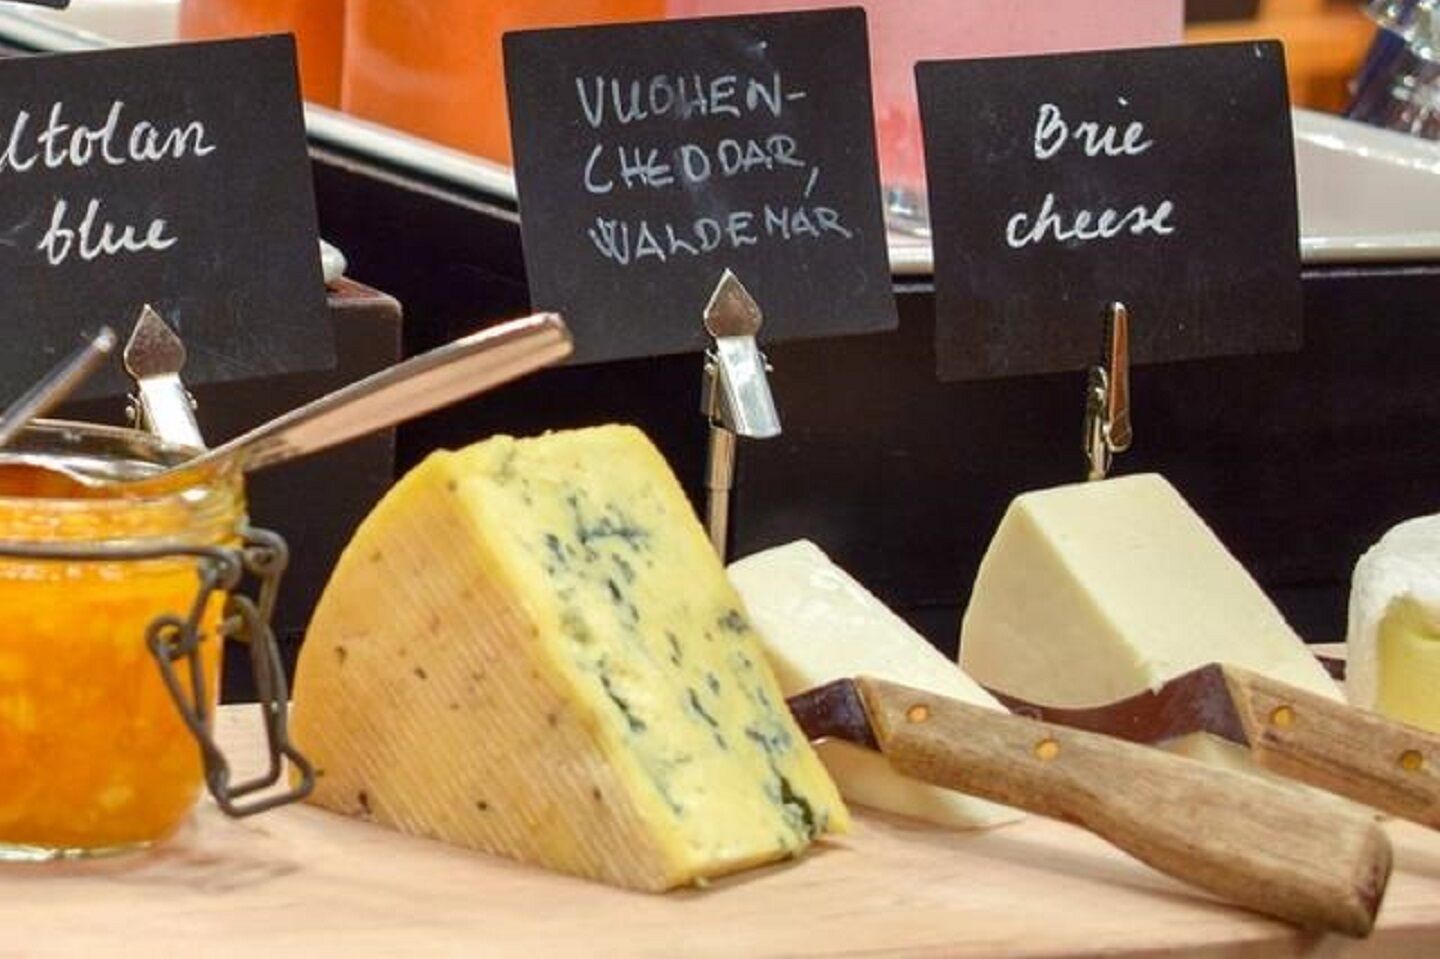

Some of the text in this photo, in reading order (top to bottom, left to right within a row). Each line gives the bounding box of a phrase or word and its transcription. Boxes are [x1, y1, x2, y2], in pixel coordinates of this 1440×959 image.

[1034, 97, 1152, 159] Brie
[38, 198, 178, 265] blue
[588, 205, 853, 265] WALDEMAR
[1006, 193, 1174, 247] cheese
